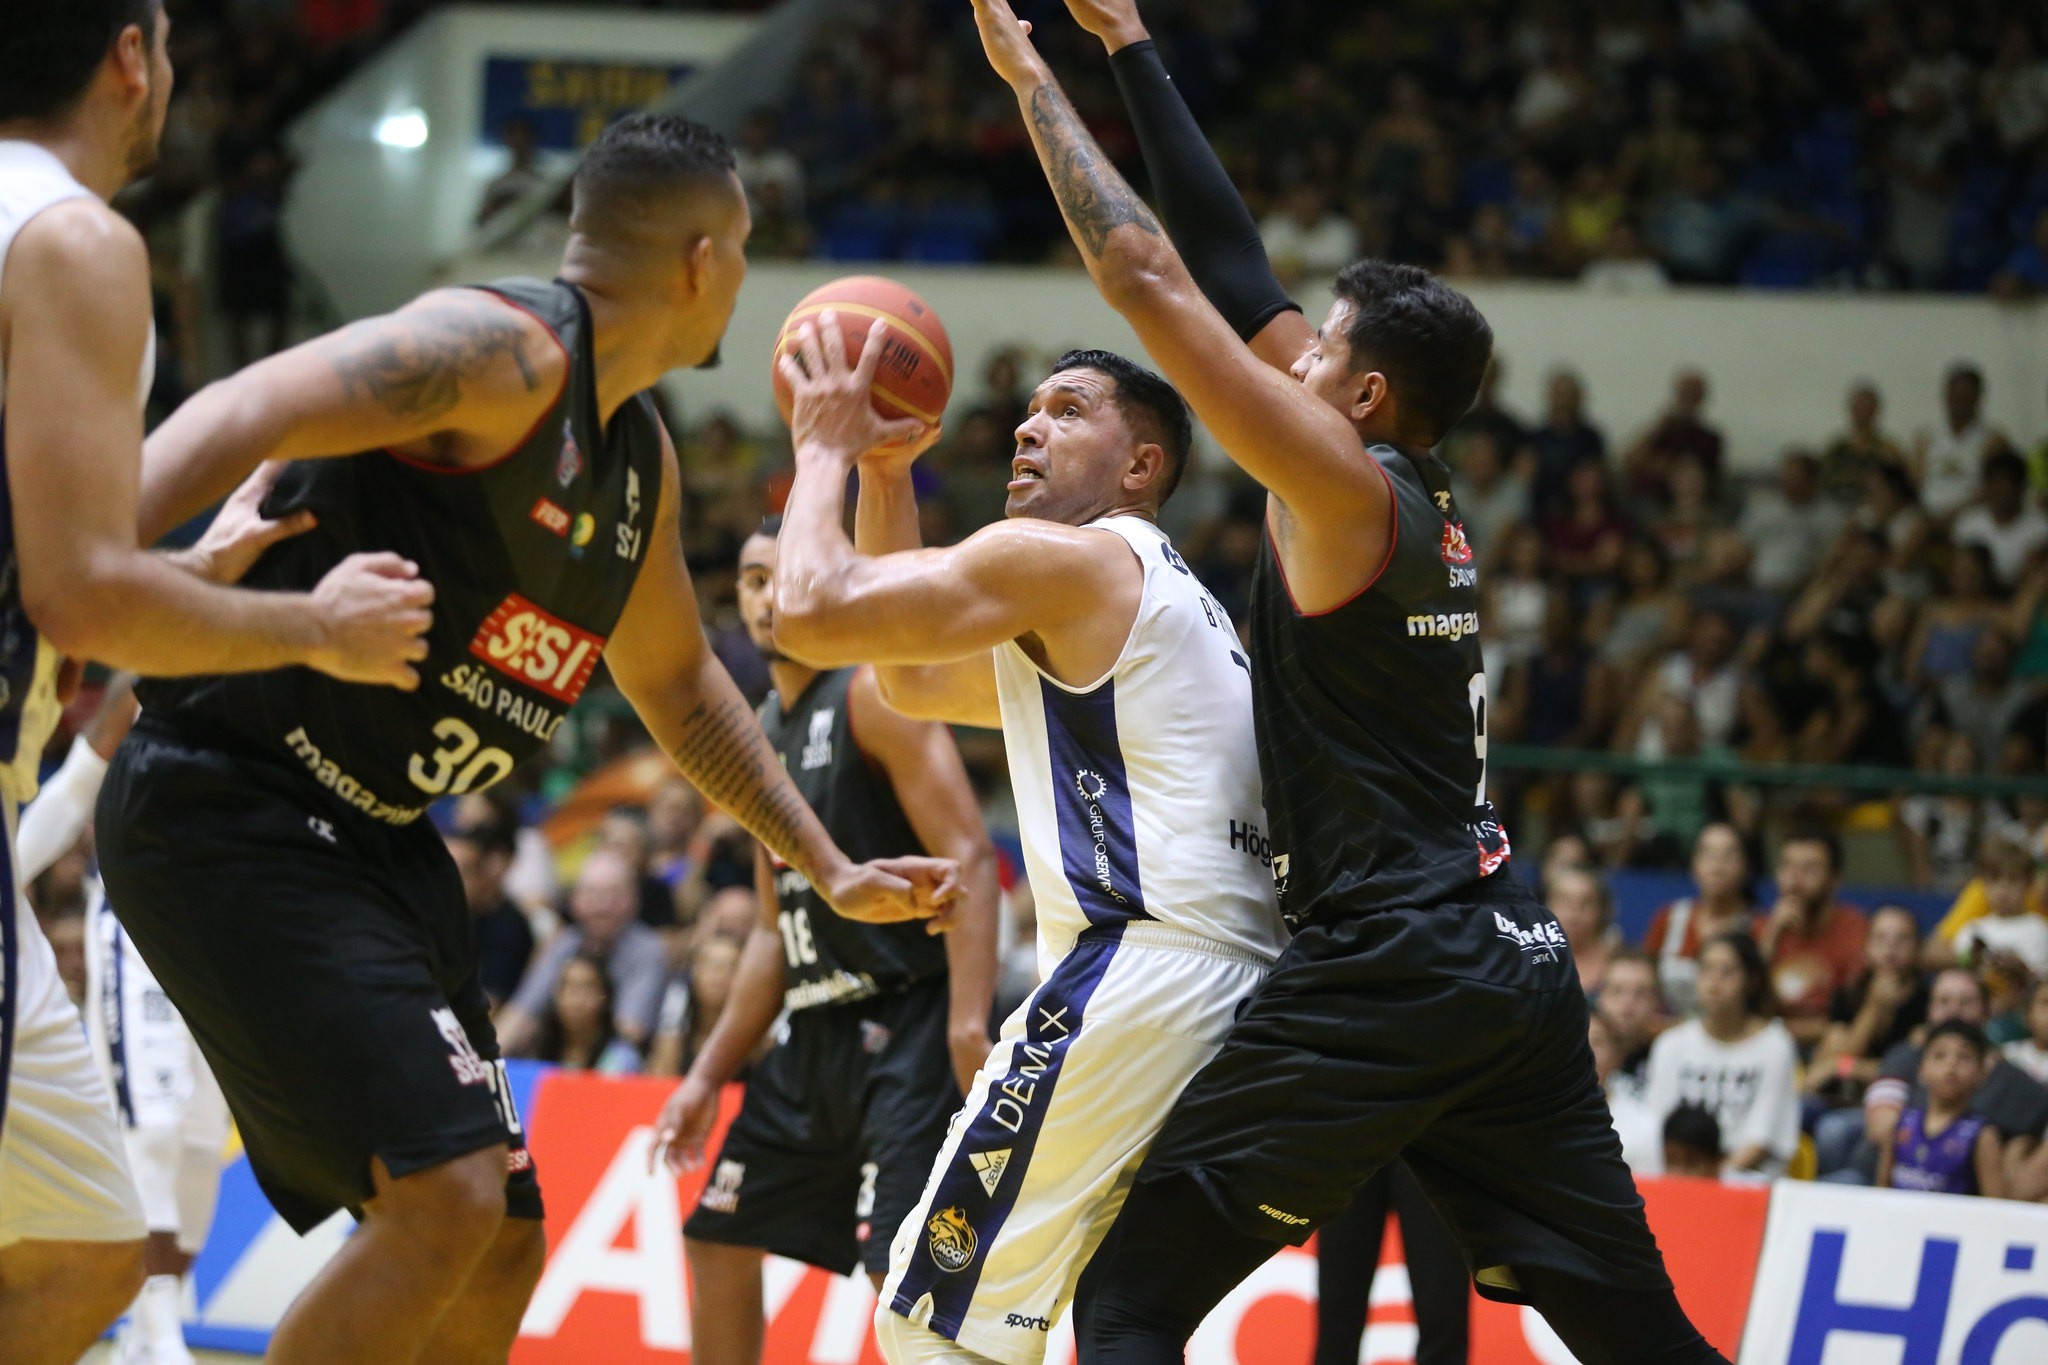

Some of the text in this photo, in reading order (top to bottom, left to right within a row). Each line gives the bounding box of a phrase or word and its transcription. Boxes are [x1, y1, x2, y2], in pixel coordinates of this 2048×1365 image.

[487, 611, 592, 692] SESI
[440, 664, 494, 709] SÃO
[408, 717, 514, 796] 30
[991, 1006, 1069, 1134] DEMAX
[985, 1153, 1006, 1186] DEMAX
[935, 1242, 966, 1265] MOGI
